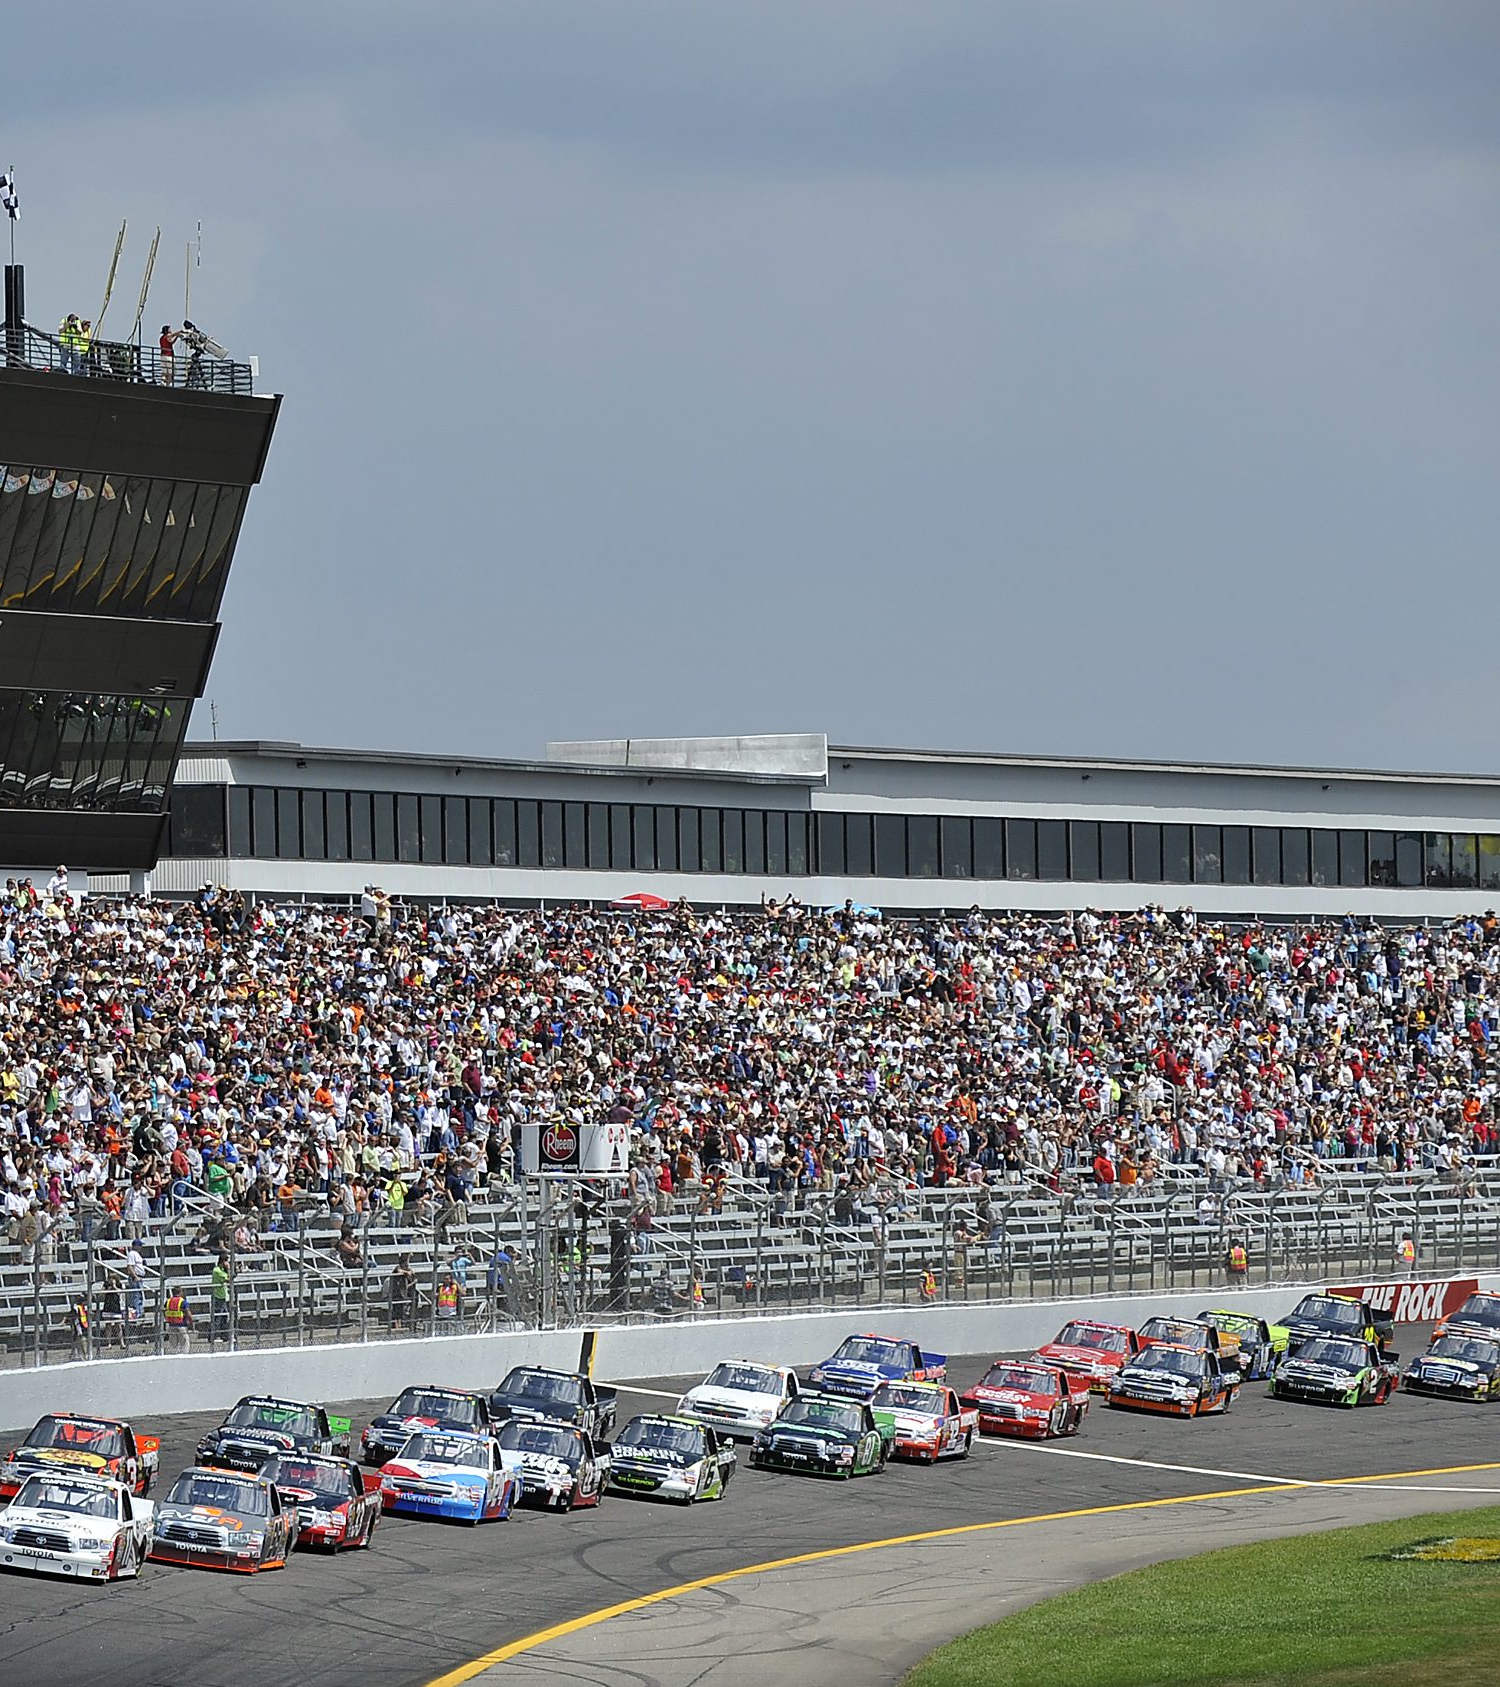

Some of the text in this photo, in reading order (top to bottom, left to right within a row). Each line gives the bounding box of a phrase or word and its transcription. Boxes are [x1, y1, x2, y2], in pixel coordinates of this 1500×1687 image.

[546, 1130, 574, 1155] Rheem
[1394, 1283, 1450, 1322] ROCK
[229, 1459, 258, 1468] TOYOTA
[278, 1455, 337, 1468] CAMPING WORLD
[40, 1478, 104, 1492] CAMPING WORLD
[191, 1474, 254, 1488] CAMPING WORLD
[395, 1492, 443, 1505] SILVERADO
[21, 1548, 55, 1559] TOYOTA
[175, 1541, 207, 1553] TOYOTA
